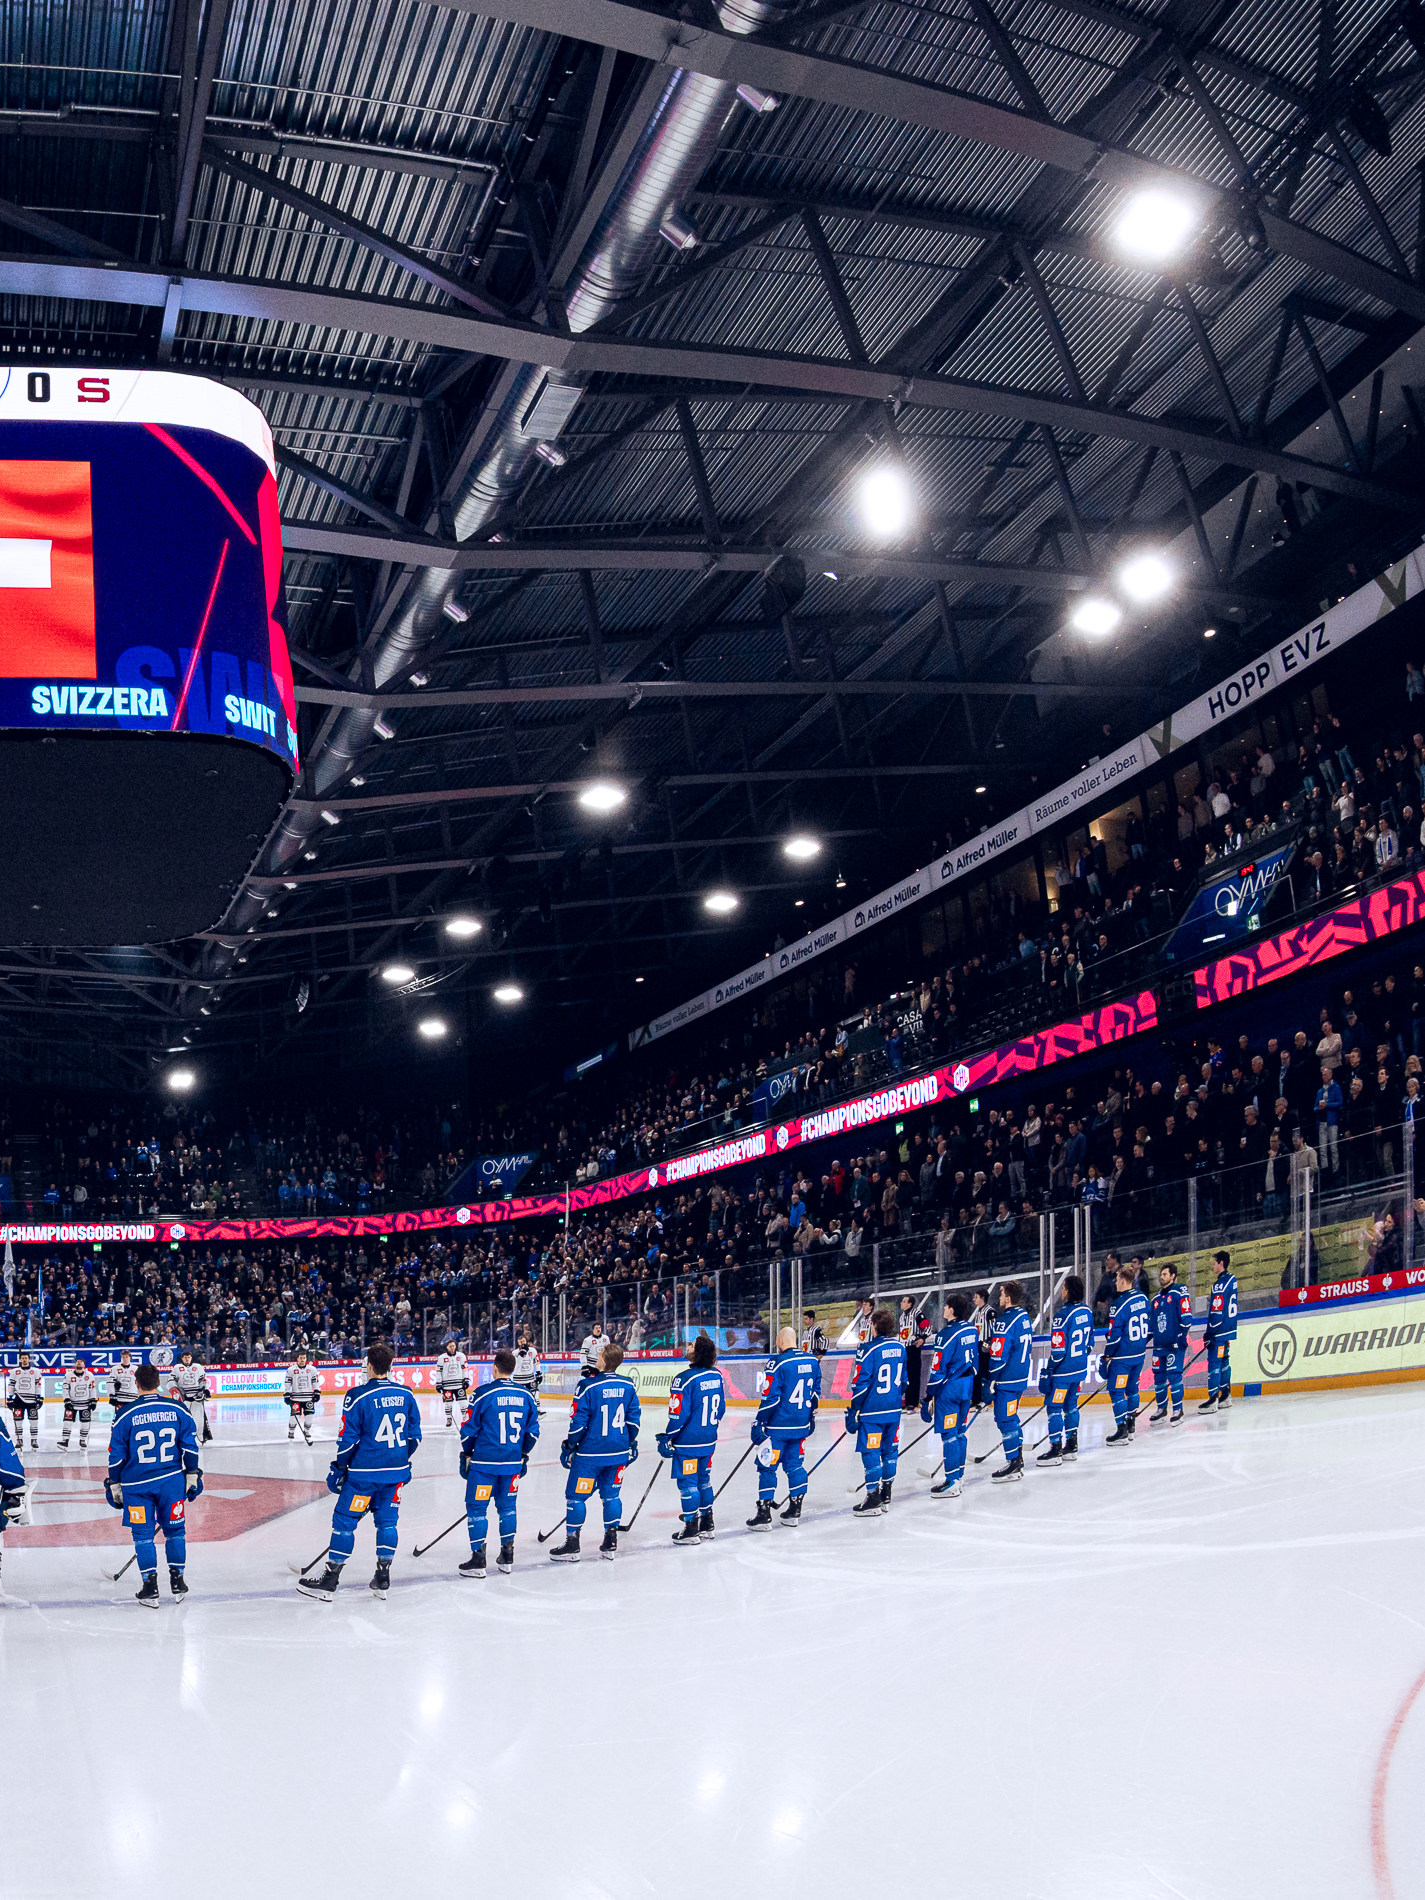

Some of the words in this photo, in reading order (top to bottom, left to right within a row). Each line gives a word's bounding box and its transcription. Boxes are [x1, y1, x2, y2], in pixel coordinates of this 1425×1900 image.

[27, 372, 51, 403] 0
[77, 377, 111, 403] S
[1208, 661, 1270, 719] HOPP
[1280, 622, 1331, 672] EVZ
[31, 685, 168, 717] SVIZZERA
[224, 694, 276, 738] SWIT
[1034, 793, 1070, 823] Räume
[1071, 776, 1102, 800] voller
[1102, 753, 1138, 783] Leben
[956, 843, 986, 872] Alfred
[988, 827, 1018, 853] Müller
[867, 898, 893, 921] Alfred
[894, 883, 921, 907] Müller
[790, 942, 813, 964] Alfred
[813, 929, 838, 953] Müller
[725, 982, 745, 999] Alfred
[745, 970, 766, 988] Müller
[666, 1134, 766, 1182] #CHAMPIONSGOBEYOND
[800, 1075, 938, 1142] #CHAMPIONSGOBEYOND
[0, 1224, 155, 1241] #CHAMPIONSGOBEYOND
[171, 1227, 185, 1237] CHL
[1214, 1283, 1224, 1291] 64
[1319, 1279, 1369, 1299] STRAUSS
[1053, 1317, 1063, 1327] 27
[1228, 1294, 1237, 1318] 6
[996, 1321, 1006, 1331] 73
[1070, 1326, 1091, 1358] 27
[1128, 1312, 1148, 1342] 66
[19, 1376, 32, 1390] S
[74, 1384, 88, 1398] S
[221, 1374, 257, 1384] FOLLOW
[258, 1373, 268, 1383] US
[221, 1382, 283, 1392] @CHAMPIONSHOCKEY
[788, 1378, 814, 1410] 43
[876, 1362, 903, 1394] 94
[600, 1403, 625, 1437] 14
[701, 1394, 721, 1427] 18
[374, 1412, 407, 1449] 42
[498, 1411, 524, 1445] 15
[135, 1427, 176, 1464] 22
